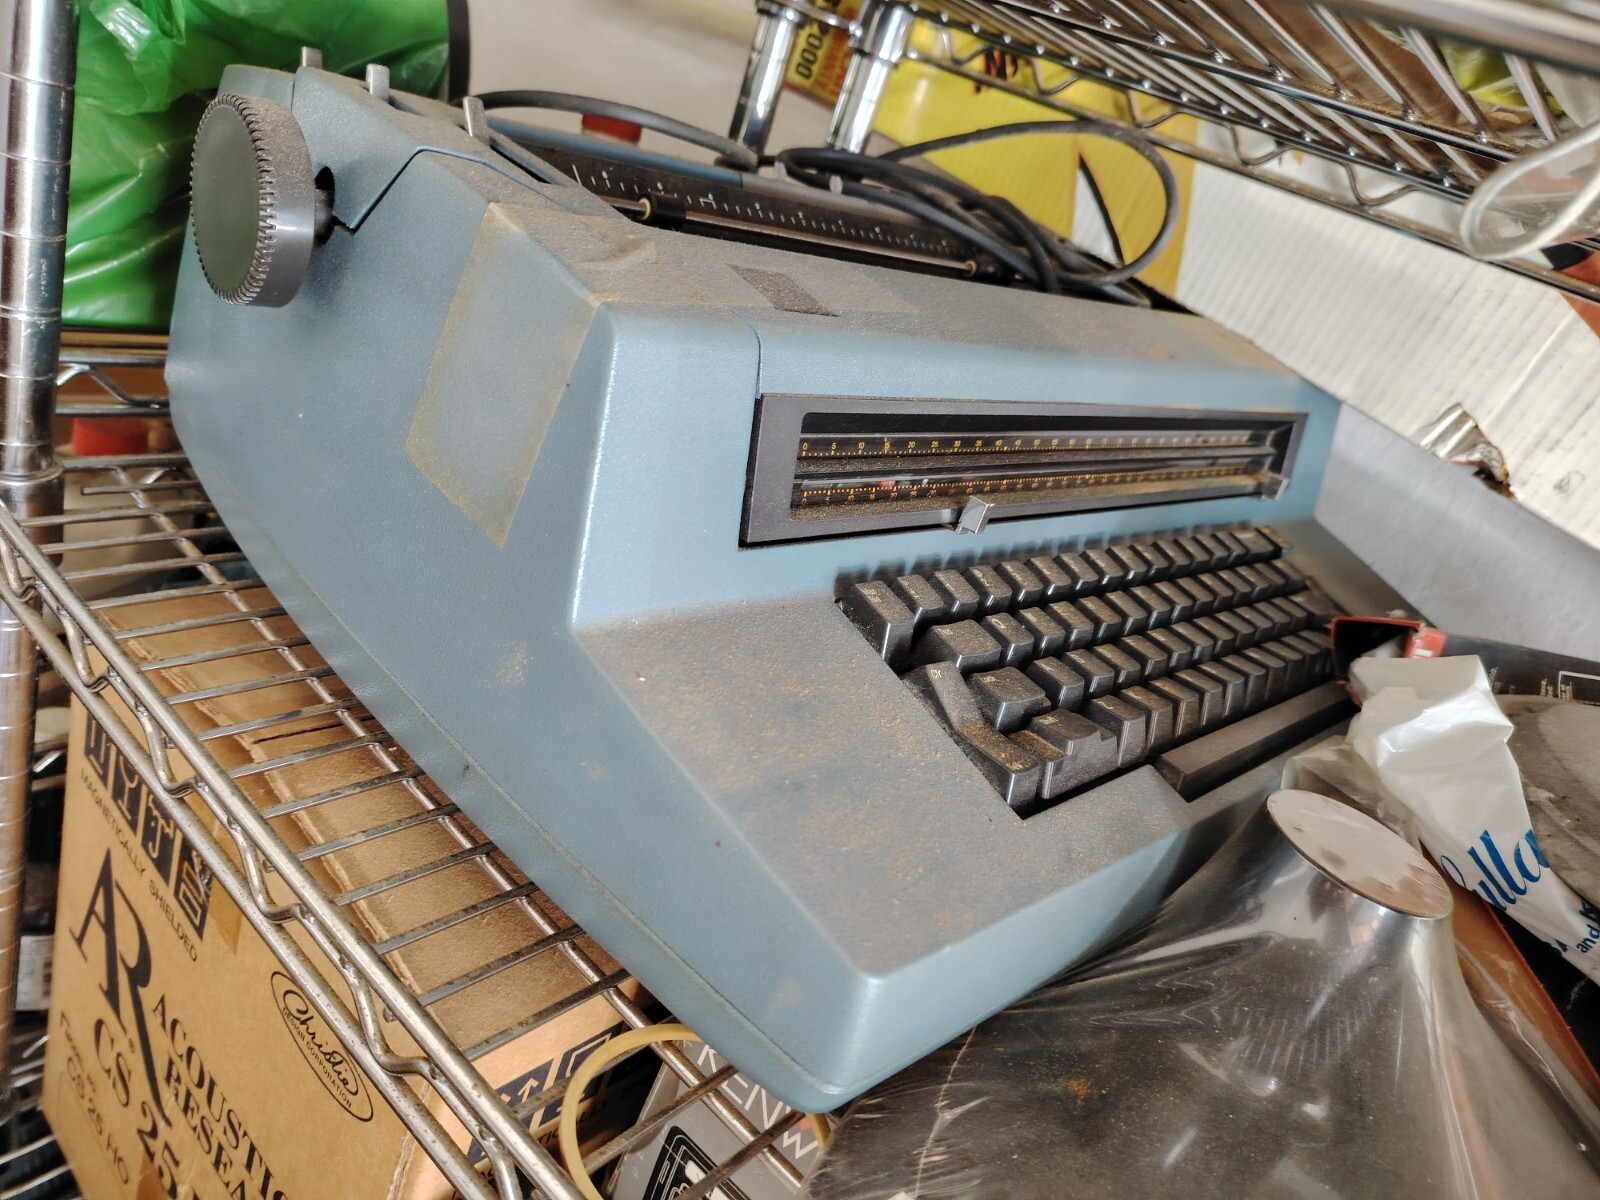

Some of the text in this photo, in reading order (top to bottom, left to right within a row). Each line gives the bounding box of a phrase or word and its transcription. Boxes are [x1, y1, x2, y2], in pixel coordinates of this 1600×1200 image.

[81, 766, 198, 962] MAGNETICALLY SHIELDED
[282, 1006, 353, 1109] DESIGN CORPORATION
[283, 989, 359, 1096] Christie
[87, 1097, 103, 1136] 25
[94, 1017, 178, 1200] CS 25
[697, 1043, 821, 1161] KENW
